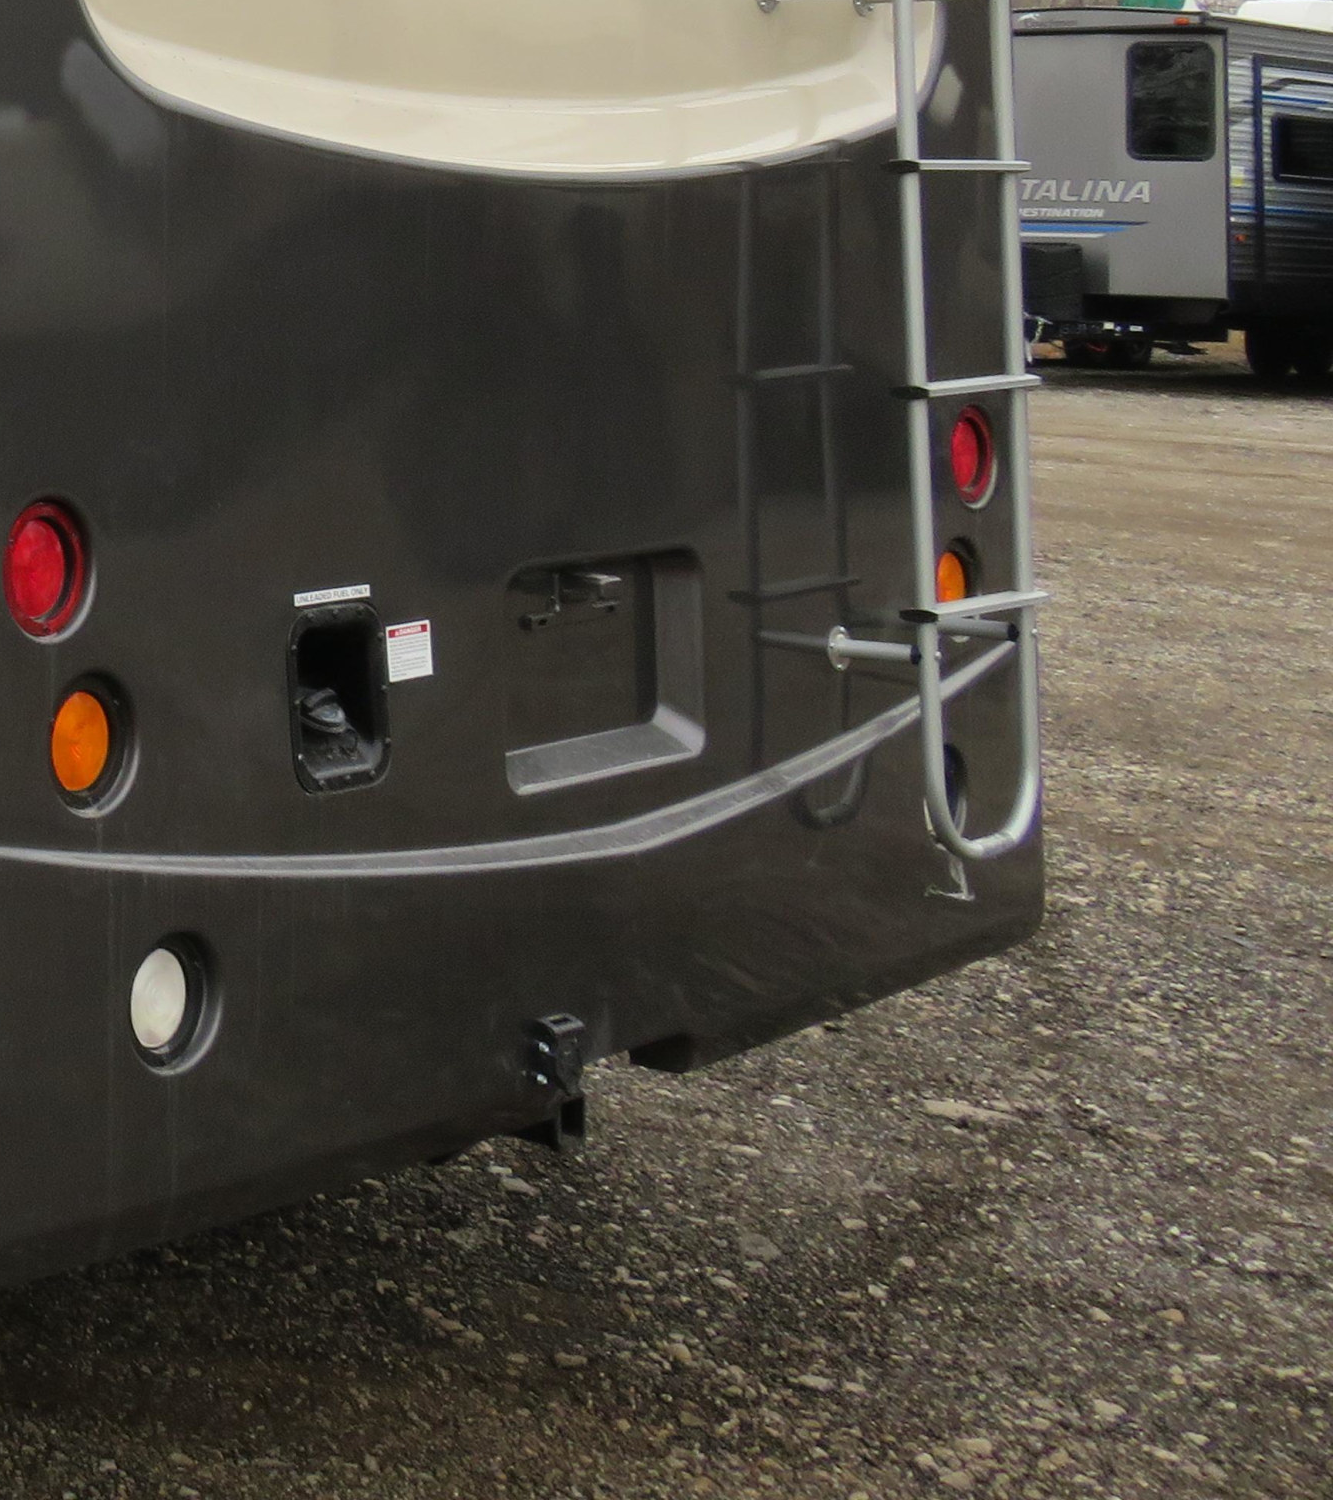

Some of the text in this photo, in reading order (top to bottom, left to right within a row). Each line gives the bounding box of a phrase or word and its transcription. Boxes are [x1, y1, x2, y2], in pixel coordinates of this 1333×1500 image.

[1019, 207, 1105, 218] ESTINATION
[296, 586, 368, 604] UNLEADED FUEL ONLY
